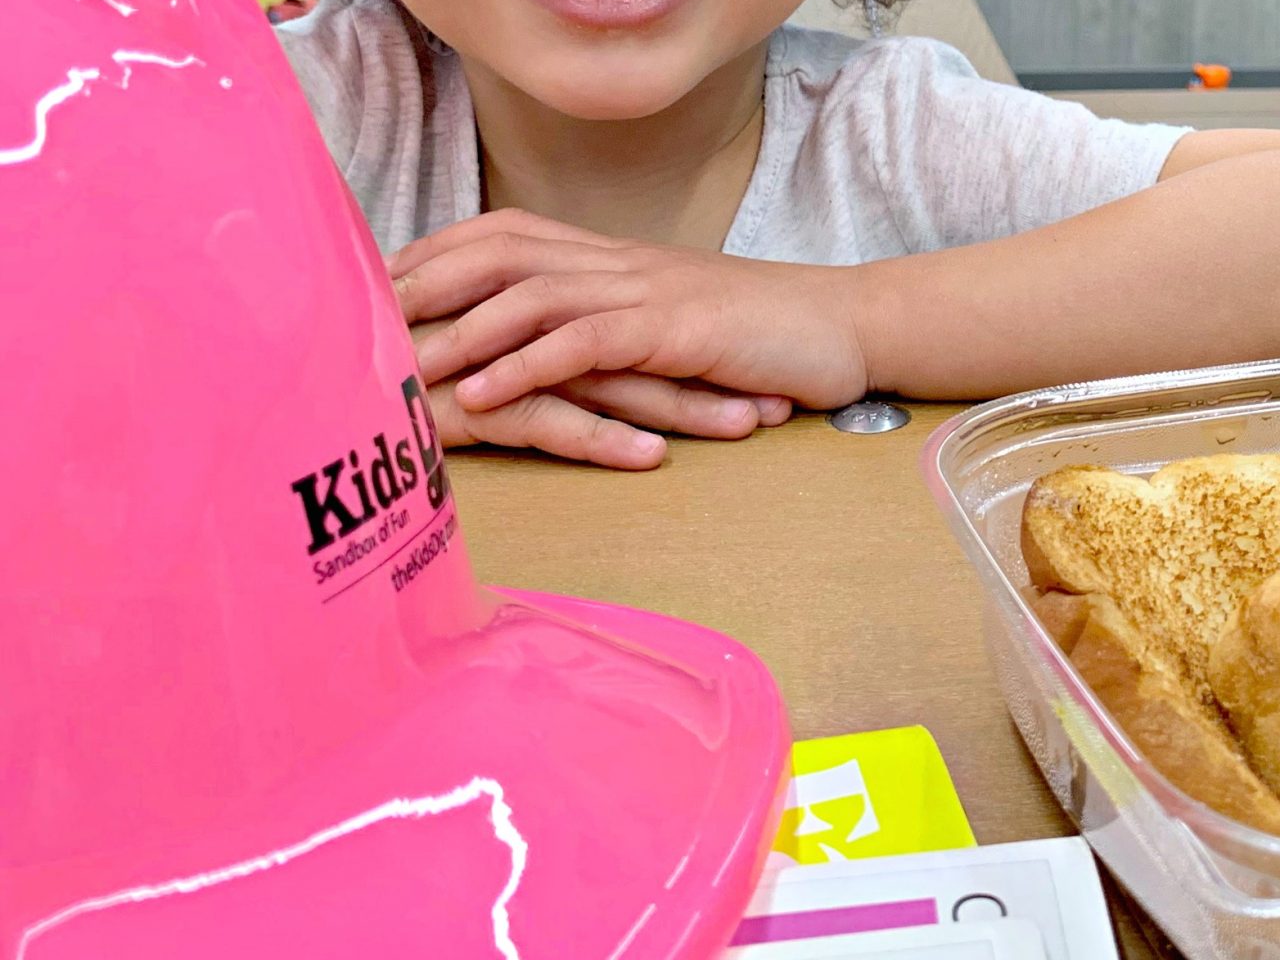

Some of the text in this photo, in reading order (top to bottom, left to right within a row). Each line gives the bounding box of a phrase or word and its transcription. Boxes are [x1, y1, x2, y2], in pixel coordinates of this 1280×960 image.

[290, 431, 419, 557] Kids
[313, 536, 380, 585] Sandbox
[390, 508, 411, 534] Fun
